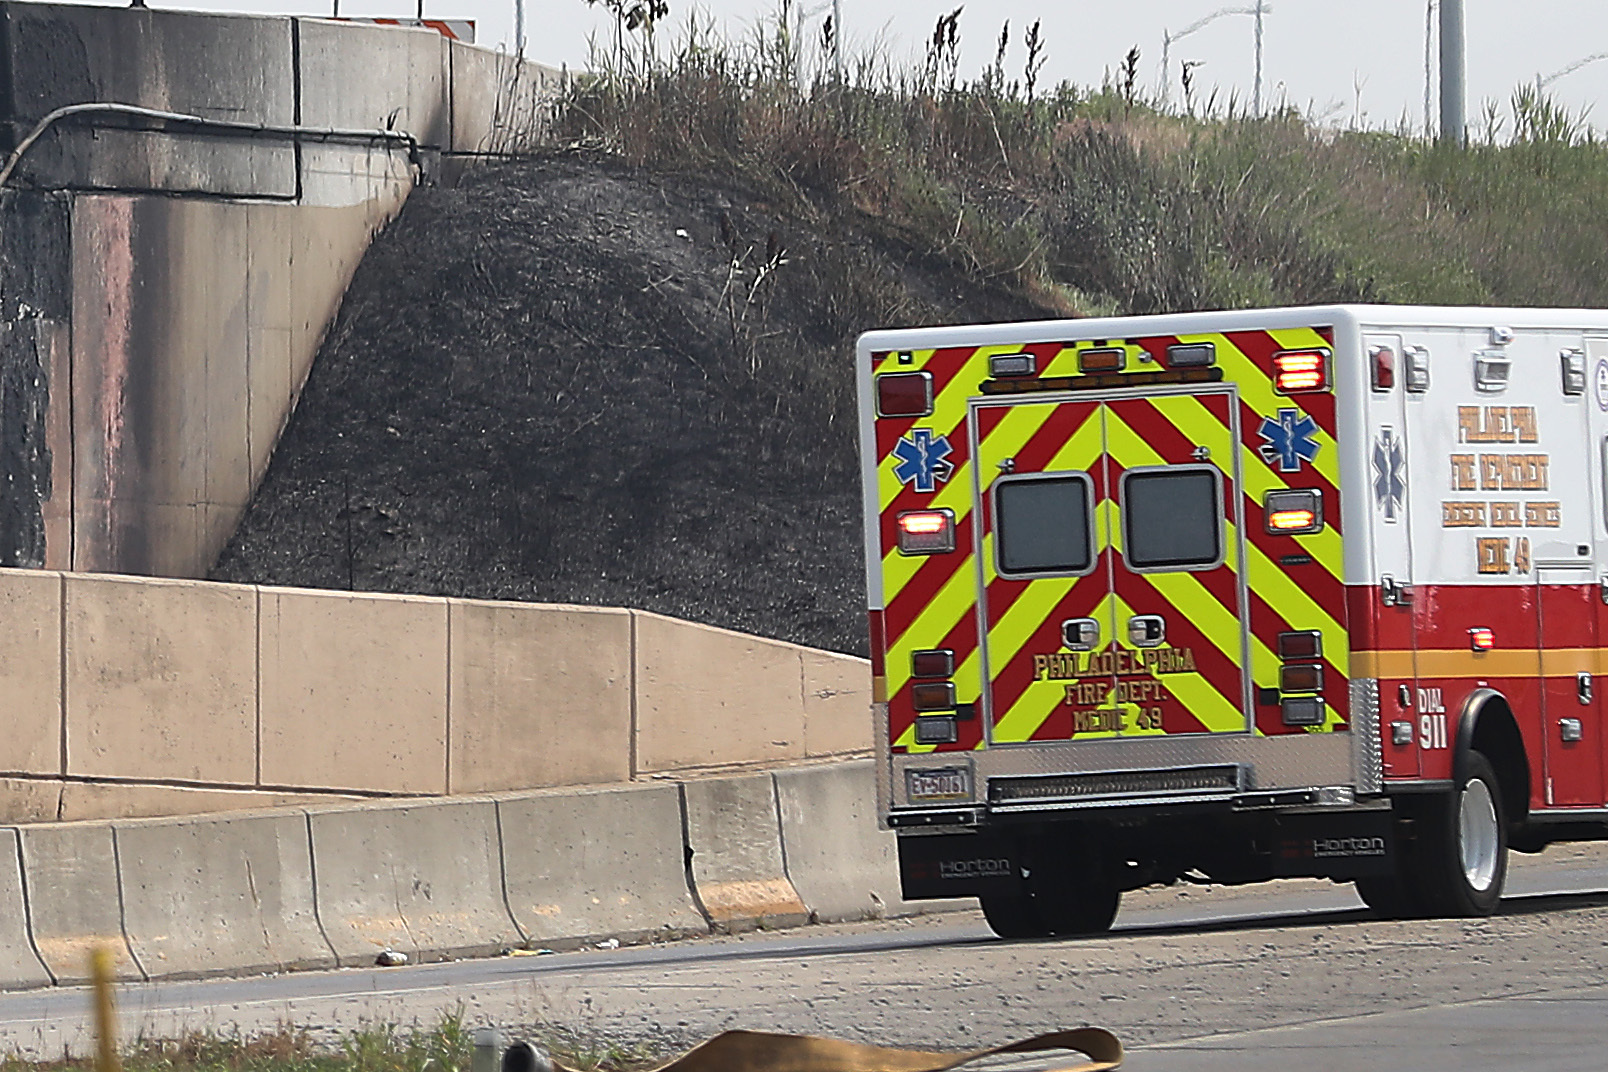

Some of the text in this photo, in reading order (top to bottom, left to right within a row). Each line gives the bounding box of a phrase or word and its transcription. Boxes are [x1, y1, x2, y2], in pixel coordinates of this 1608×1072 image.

[1033, 648, 1198, 679] PHILADELPHIA
[1065, 680, 1168, 705] FIRE DEPT.
[1417, 688, 1446, 713] DIAL
[1072, 707, 1163, 732] MEDIC 49
[1419, 714, 1447, 749] 911
[1314, 837, 1384, 851] Horton
[940, 858, 1010, 872] Horton
